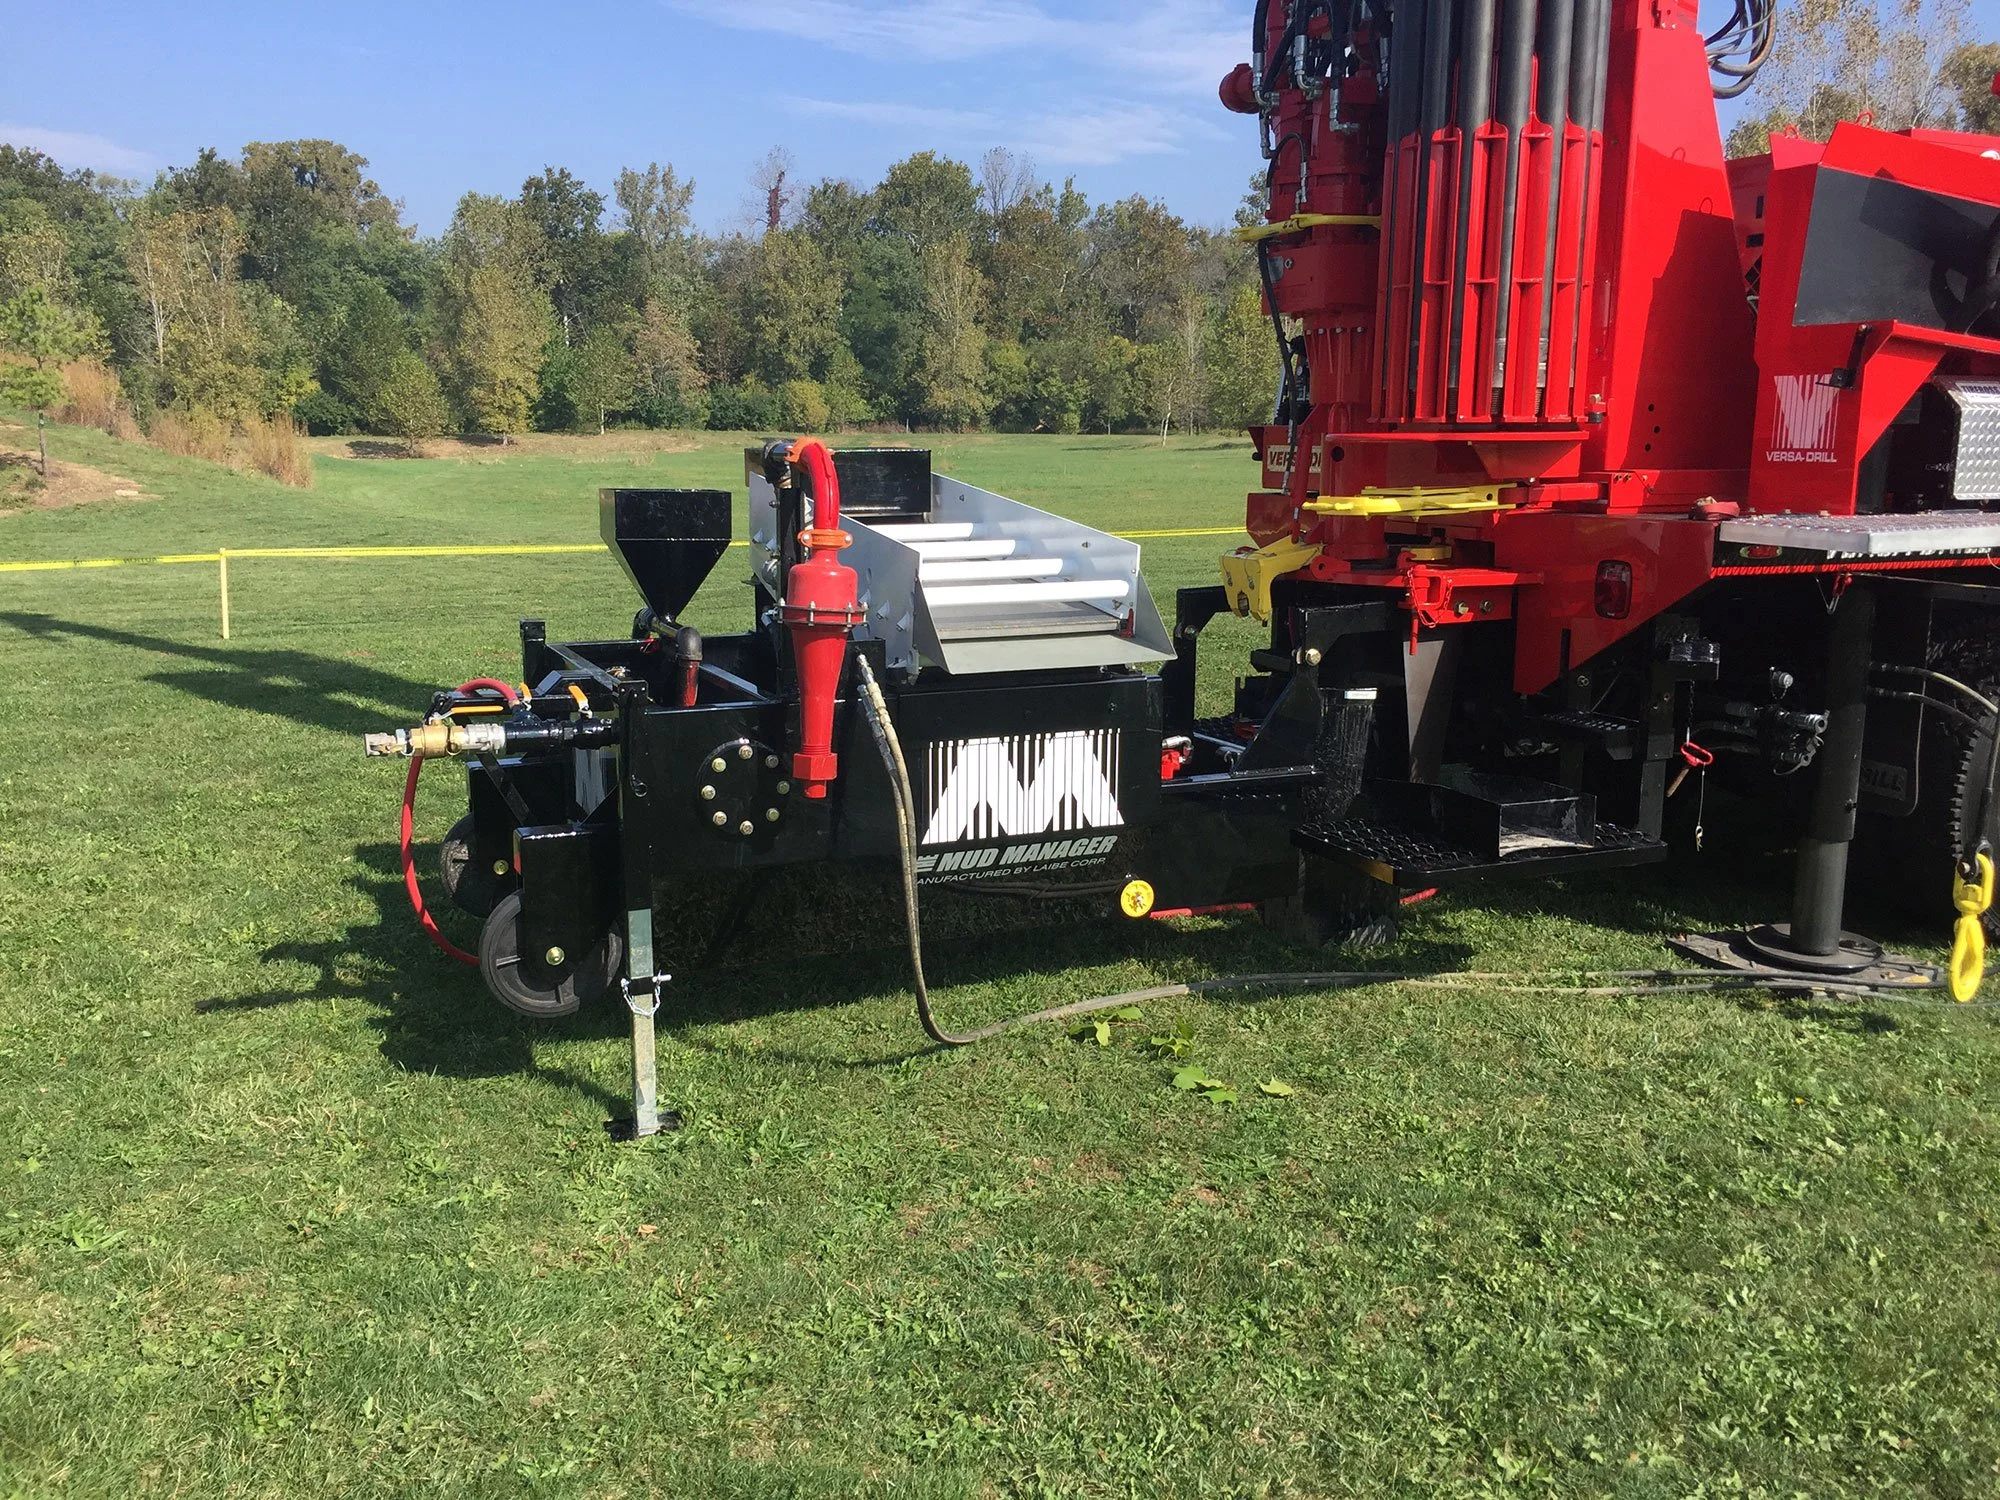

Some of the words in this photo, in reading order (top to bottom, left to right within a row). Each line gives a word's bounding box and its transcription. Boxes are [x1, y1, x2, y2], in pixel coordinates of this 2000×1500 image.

[1766, 451, 1837, 463] VERSA-DRILL
[936, 848, 999, 872] MUD
[999, 835, 1118, 865] MANAGER
[916, 868, 1011, 885] ANUFACTURED
[1013, 865, 1031, 875] BY
[1033, 861, 1069, 872] LAIBE
